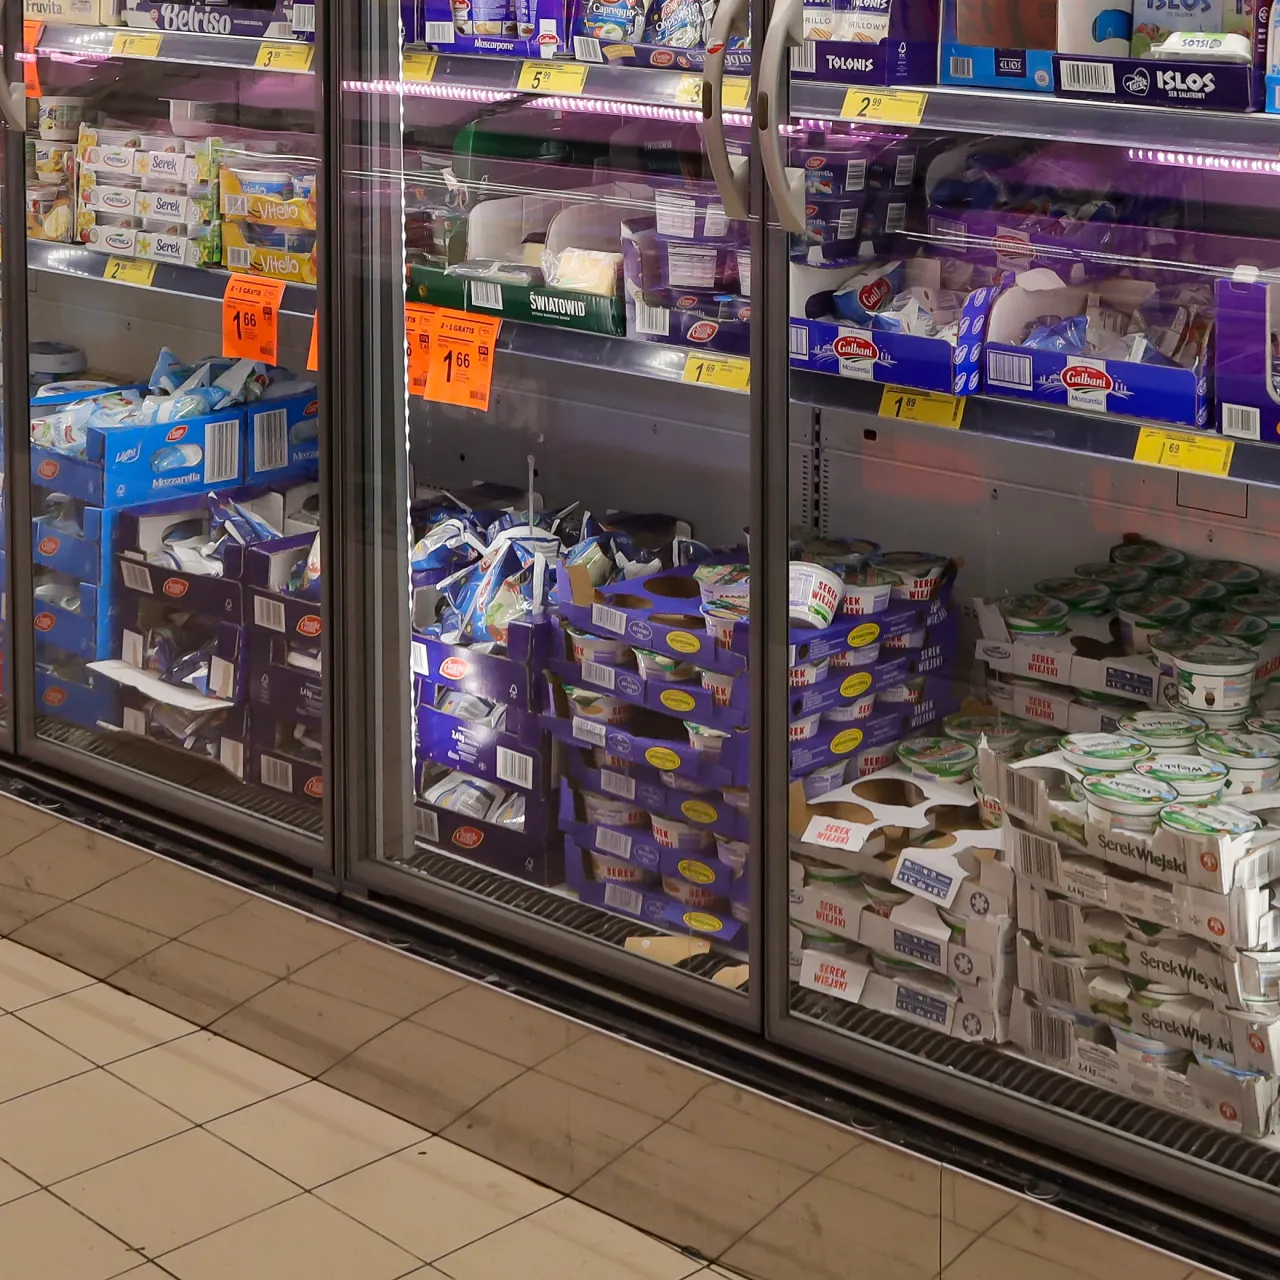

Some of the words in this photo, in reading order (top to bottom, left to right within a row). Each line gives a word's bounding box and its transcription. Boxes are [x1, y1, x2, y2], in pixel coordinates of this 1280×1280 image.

[162, 3, 231, 35] Belriso
[593, 3, 633, 17] Capreggio
[475, 39, 513, 51] Mascarpone
[1157, 70, 1215, 92] ISLOS
[860, 98, 870, 117] 2
[153, 155, 177, 173] Serek
[155, 195, 180, 213] Serek
[258, 202, 298, 220] Vitello
[260, 256, 299, 273] Vitello
[530, 291, 585, 316] ŚWIATOWID
[233, 311, 240, 340] 1
[243, 313, 256, 328] 66
[839, 341, 875, 361] Galbani
[1067, 370, 1106, 388] Galbani
[152, 472, 200, 488] Mozzarella
